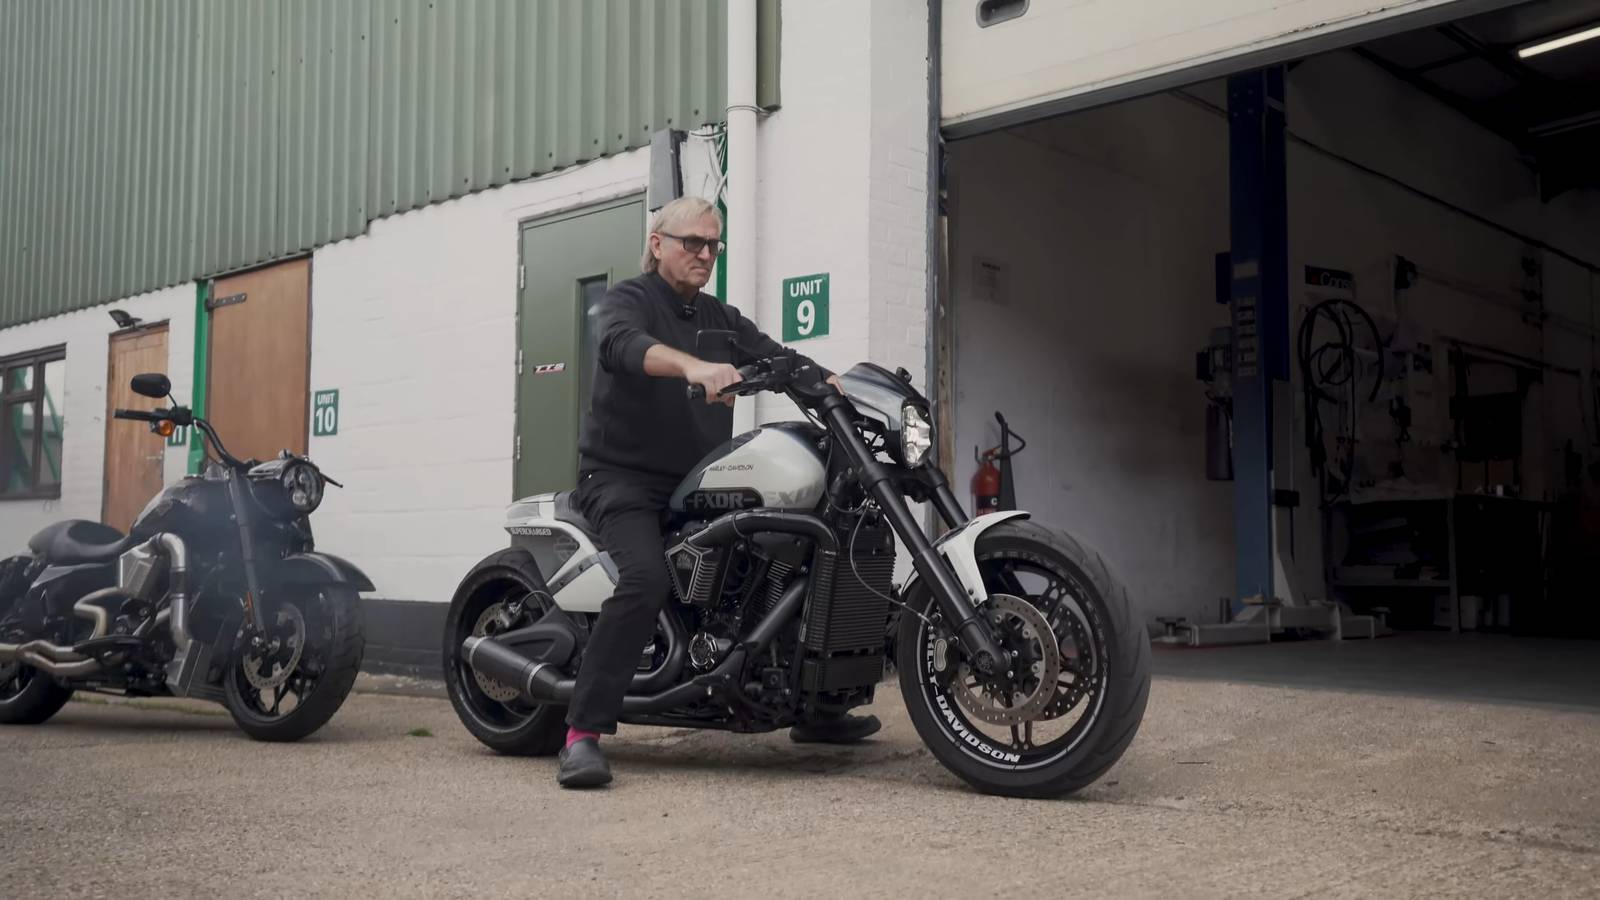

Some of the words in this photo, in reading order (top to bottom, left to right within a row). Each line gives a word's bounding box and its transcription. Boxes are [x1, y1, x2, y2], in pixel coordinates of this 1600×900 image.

[790, 279, 823, 297] UNIT
[797, 299, 815, 335] 9
[317, 392, 336, 405] UNIT
[315, 406, 336, 433] 10
